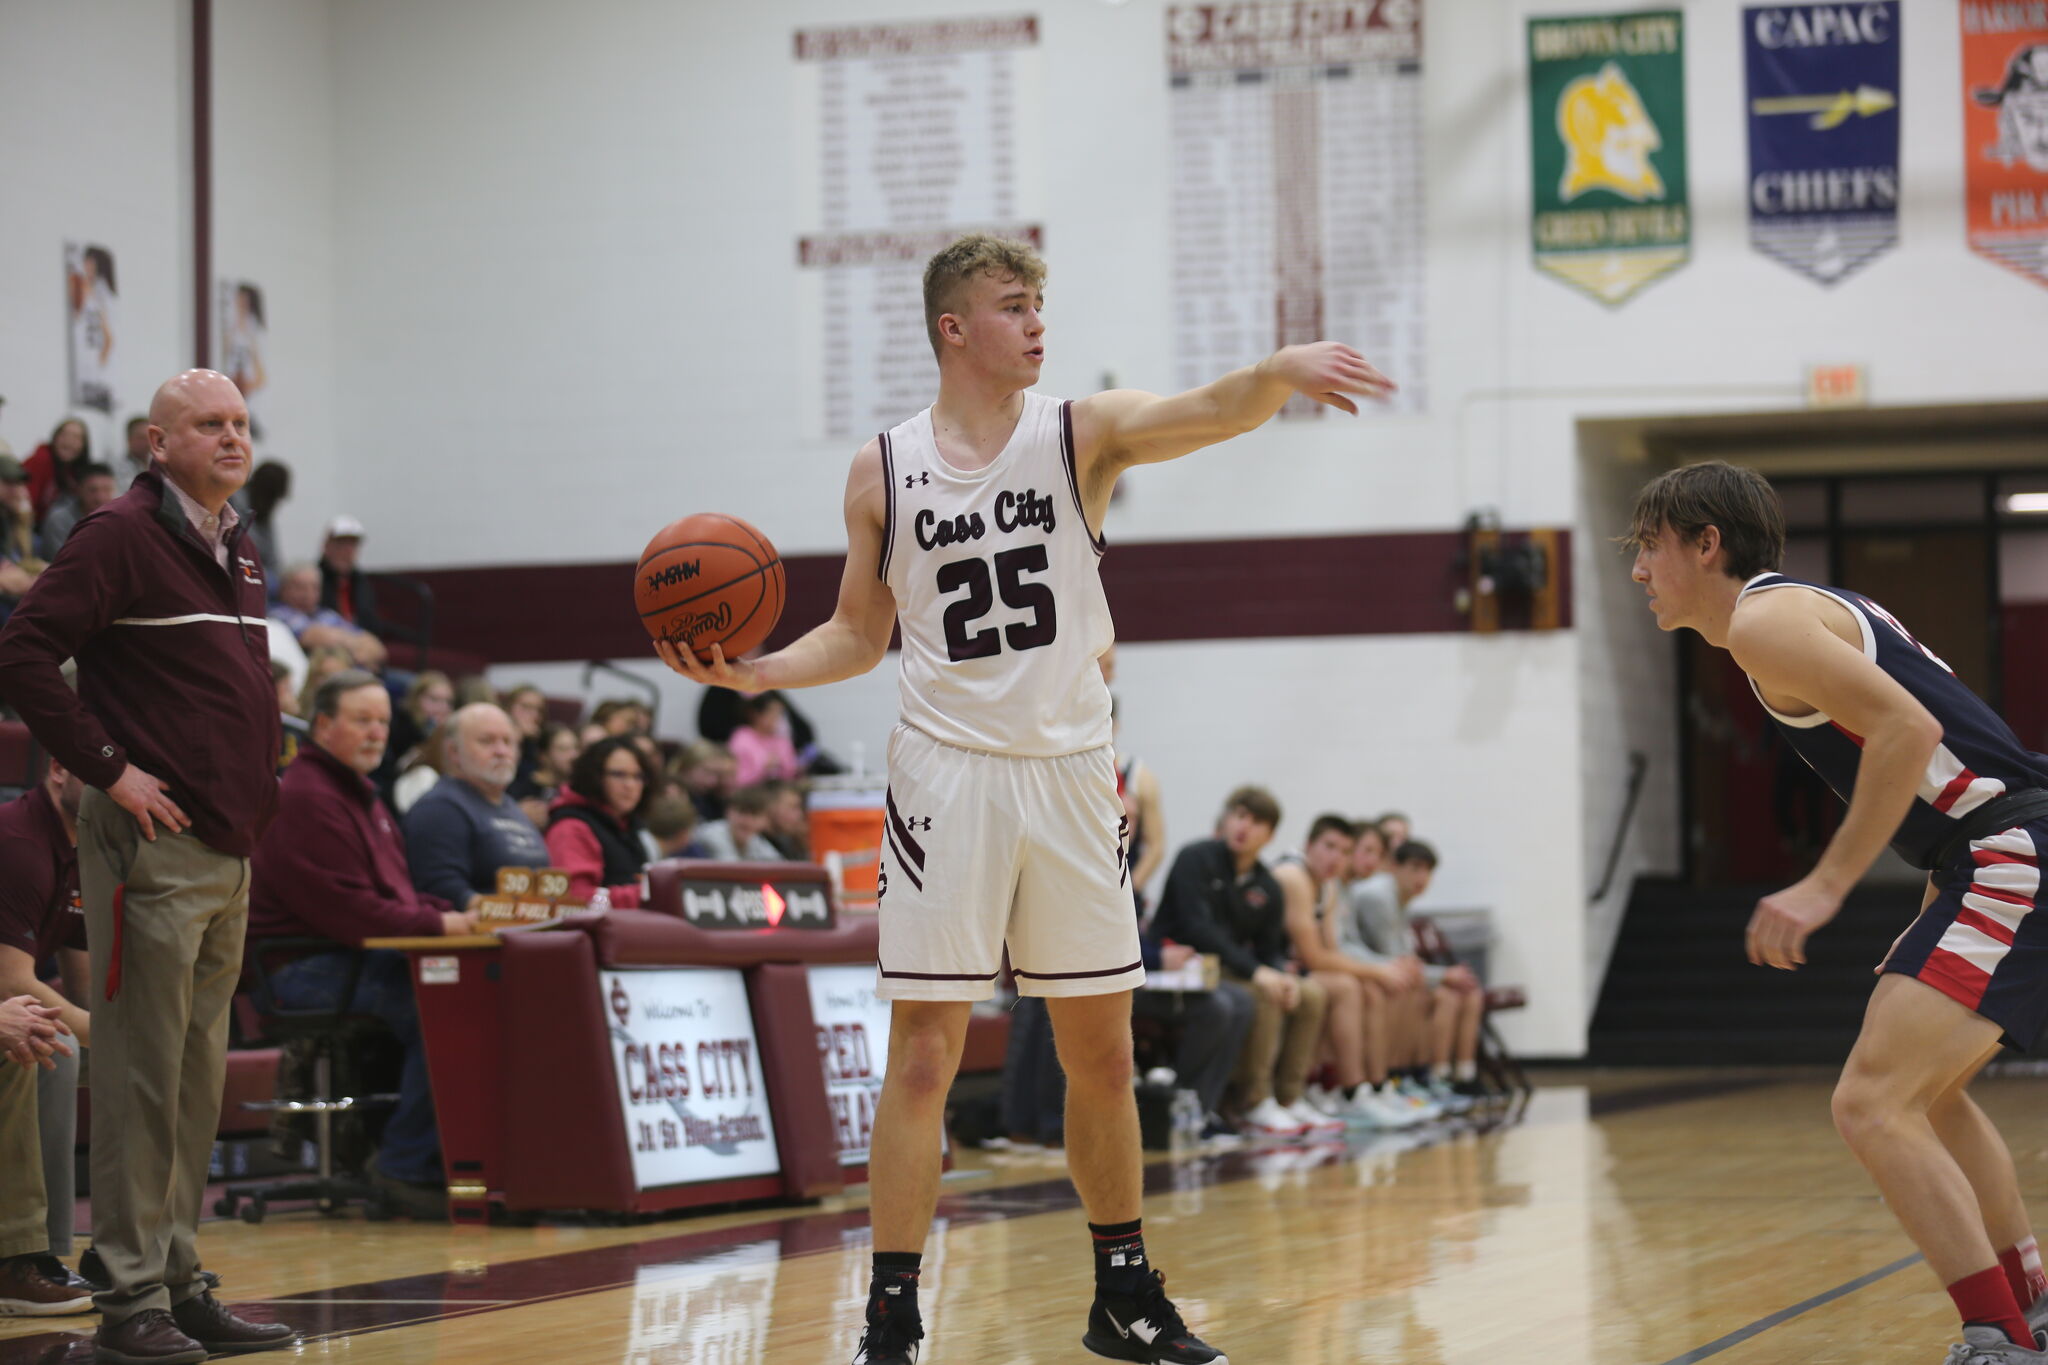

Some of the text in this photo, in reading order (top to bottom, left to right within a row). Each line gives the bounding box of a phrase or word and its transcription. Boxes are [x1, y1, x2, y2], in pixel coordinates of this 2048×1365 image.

[1620, 17, 1677, 55] CITY
[1754, 3, 1890, 50] CAPAC
[1753, 166, 1897, 214] CHIEFS
[914, 488, 1057, 551] Cass City
[936, 543, 1057, 662] 25
[625, 1038, 754, 1105] CASS CITY
